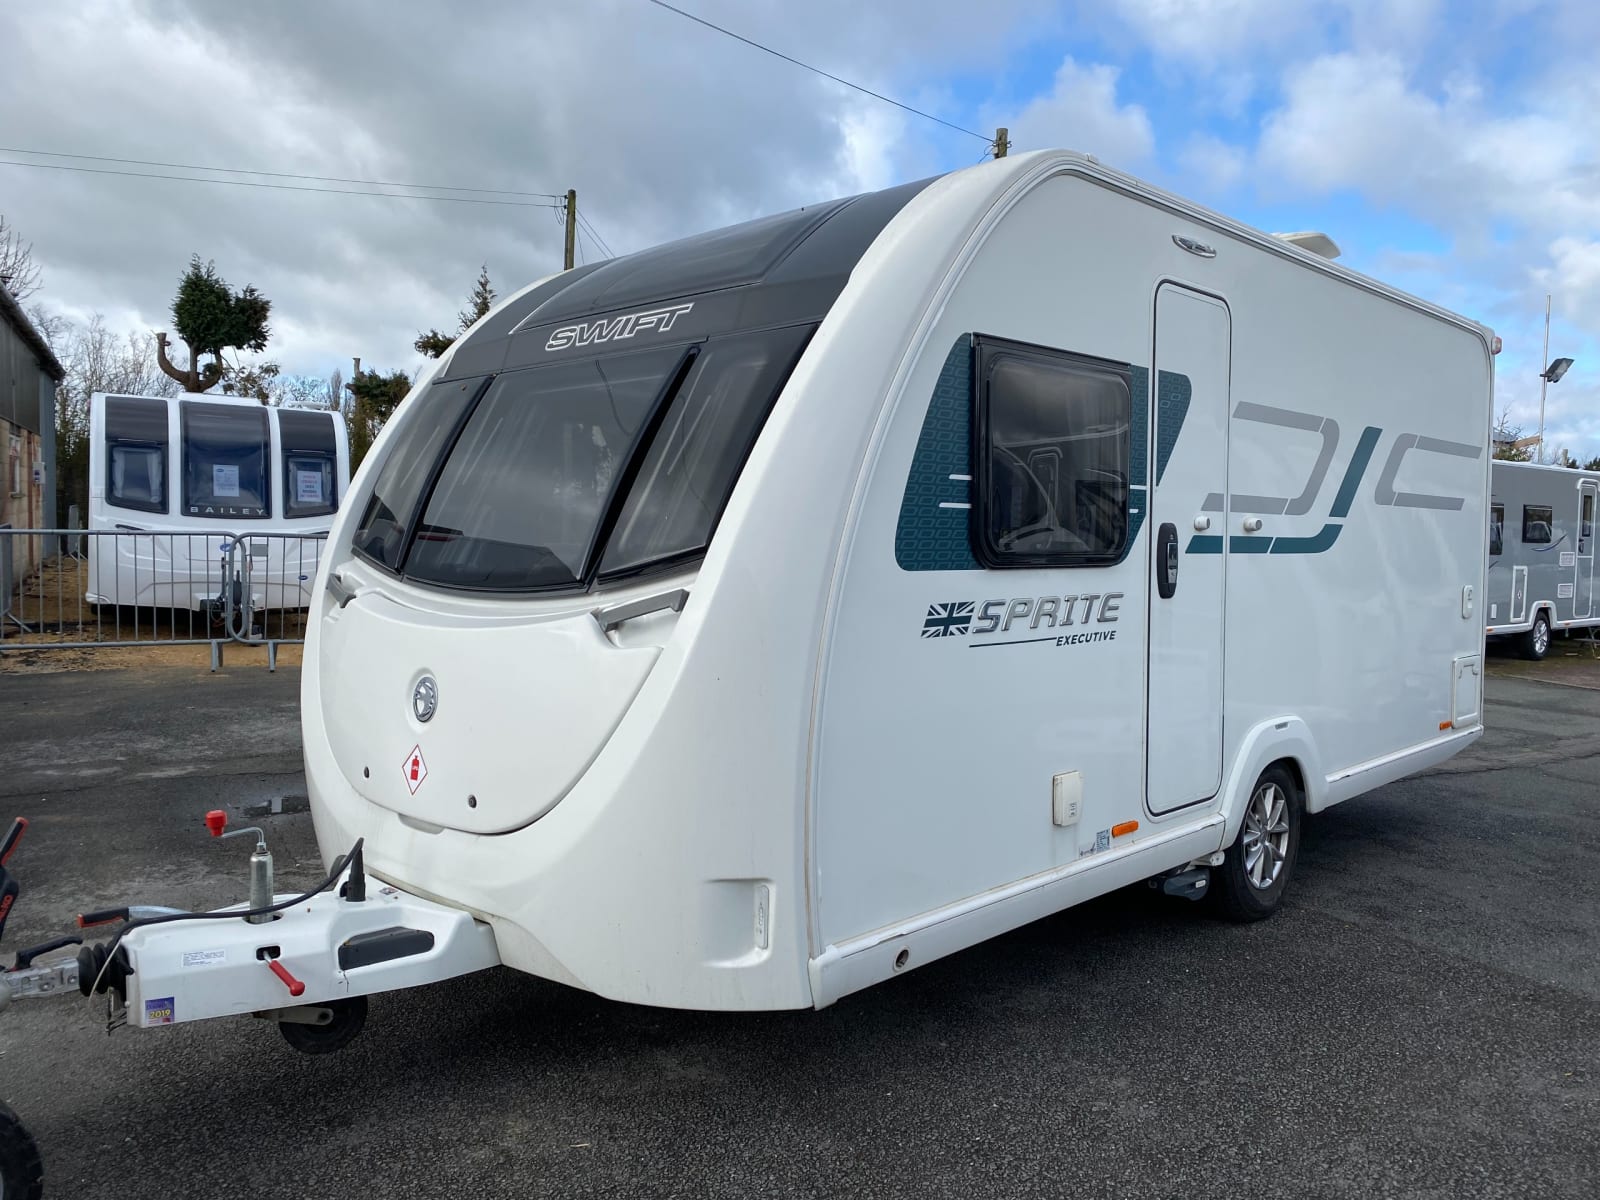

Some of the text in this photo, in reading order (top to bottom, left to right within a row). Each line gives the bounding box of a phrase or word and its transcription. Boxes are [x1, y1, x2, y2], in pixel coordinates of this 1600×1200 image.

[545, 302, 694, 351] SWIFT
[190, 506, 264, 516] BAILEY
[972, 592, 1124, 634] SPRITE
[1056, 630, 1117, 646] EXECUTIVE
[149, 1008, 171, 1019] 2019
